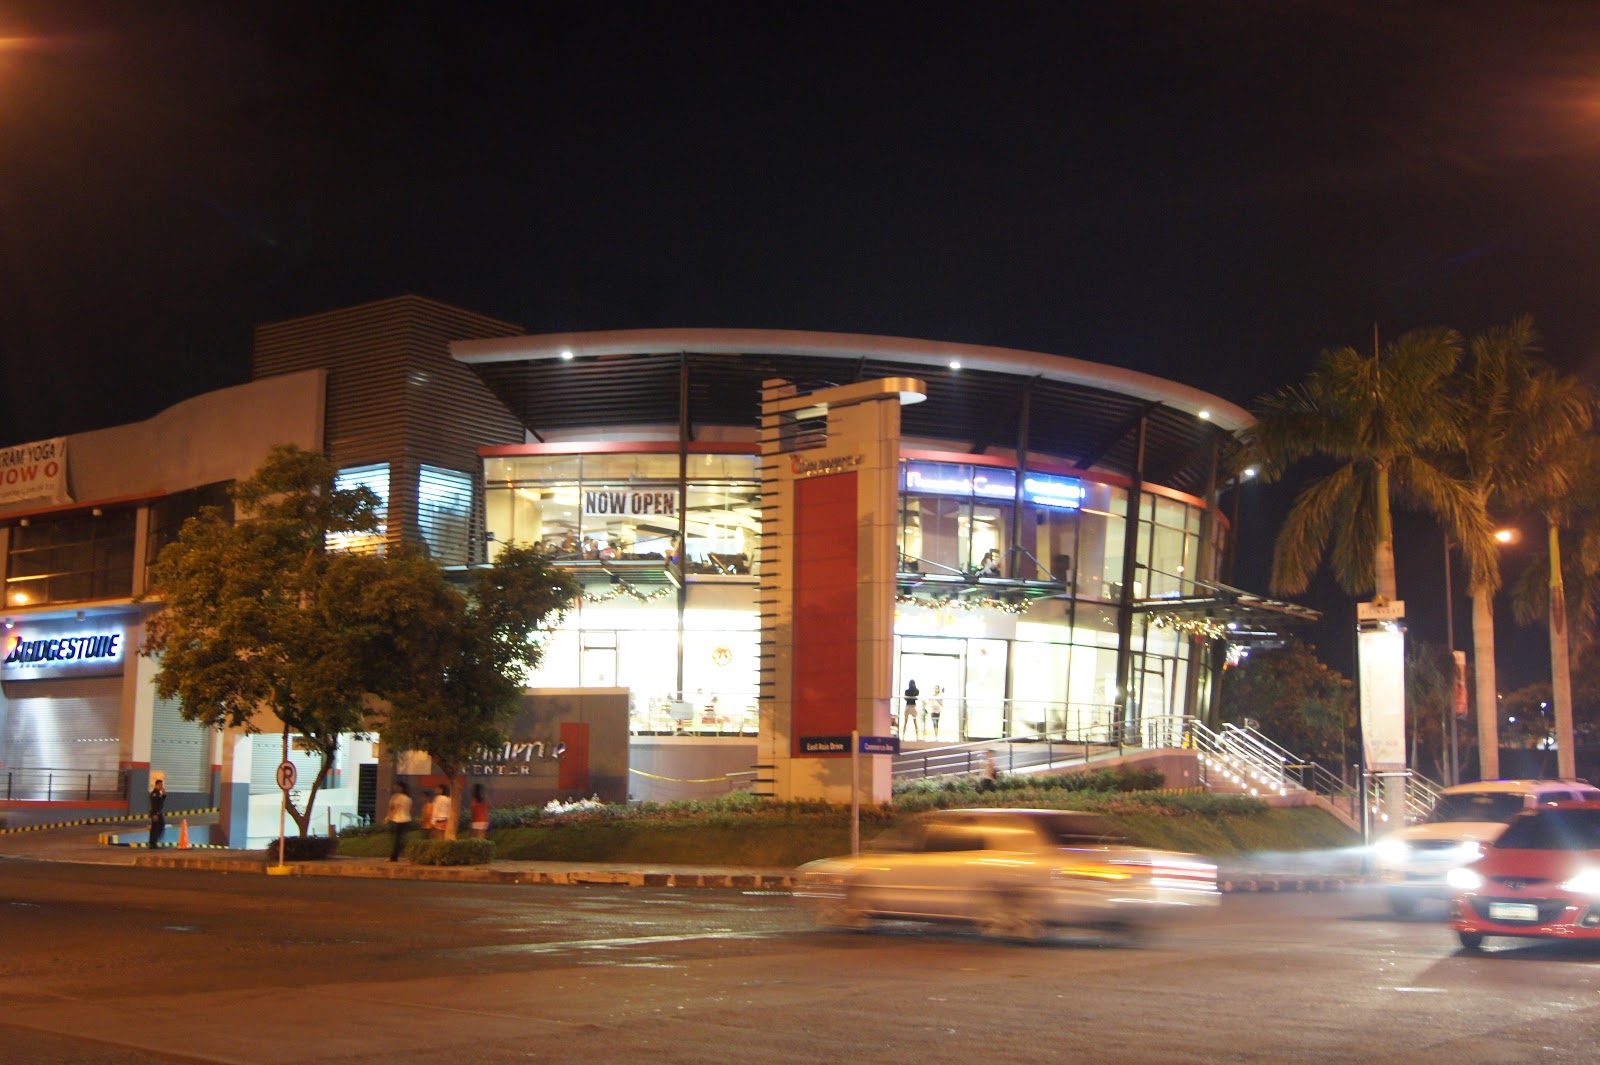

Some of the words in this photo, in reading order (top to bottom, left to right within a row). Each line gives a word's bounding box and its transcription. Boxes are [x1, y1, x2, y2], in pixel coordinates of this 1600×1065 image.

[28, 443, 56, 463] YOGA
[586, 491, 626, 514] NOW
[631, 491, 675, 515] OPEN
[4, 634, 120, 664] BRIDGESTONE
[806, 743, 818, 751] East
[830, 742, 844, 751] Drive
[283, 765, 293, 786] P
